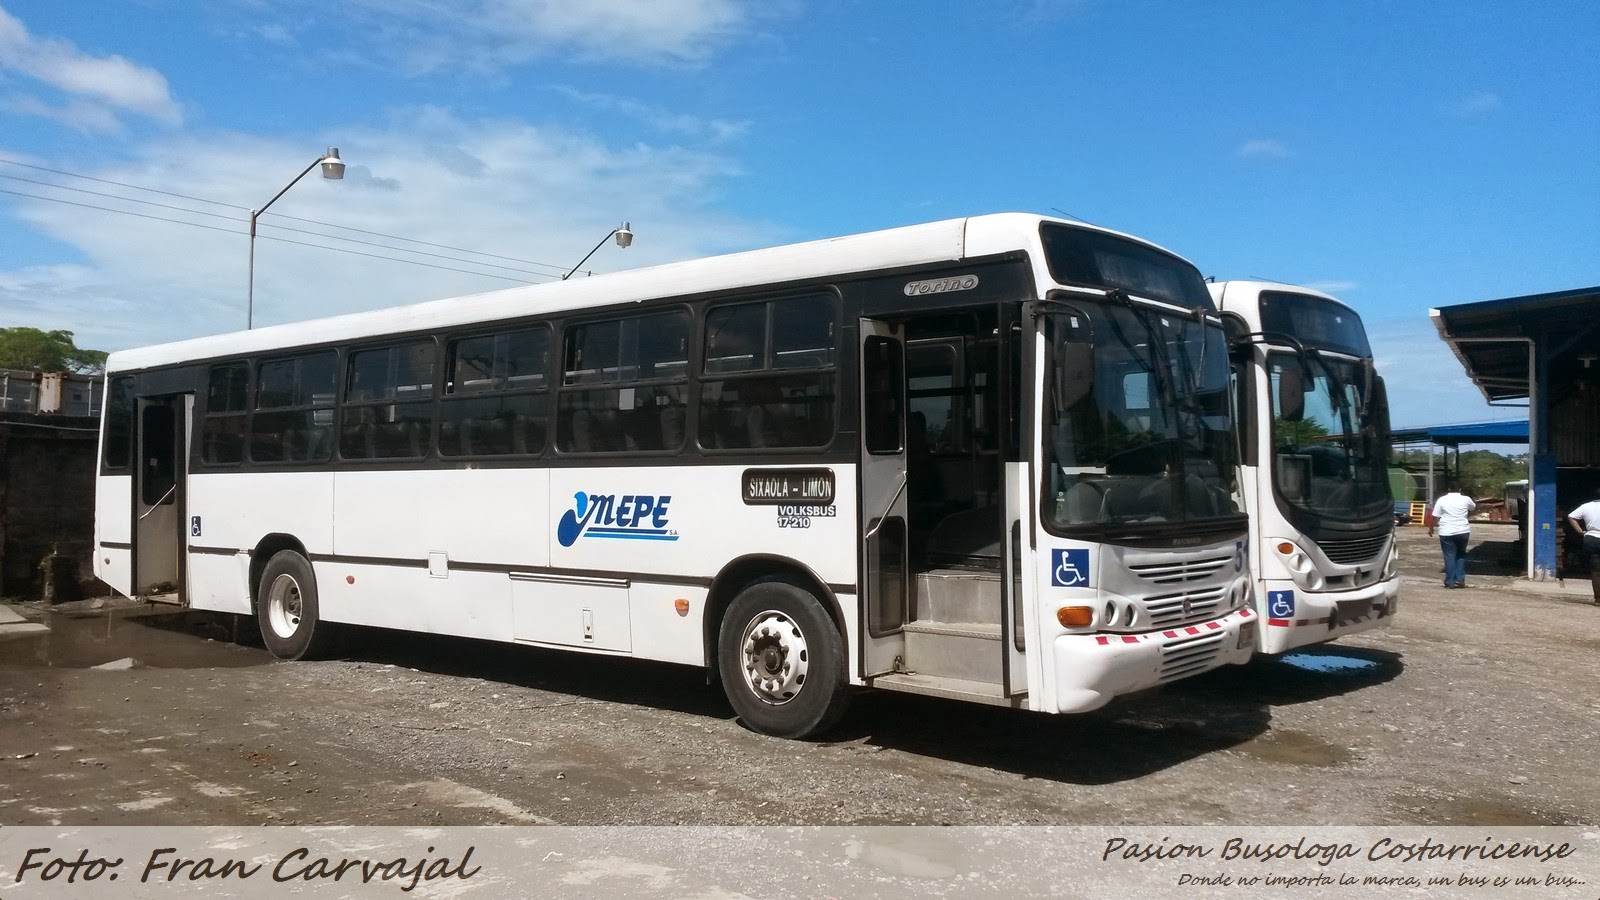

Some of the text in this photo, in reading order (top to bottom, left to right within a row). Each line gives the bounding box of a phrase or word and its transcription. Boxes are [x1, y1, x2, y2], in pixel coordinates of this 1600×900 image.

[908, 279, 975, 295] Torino
[749, 477, 789, 497] SIXAOLA
[588, 494, 672, 529] MEPE
[779, 505, 835, 516] VOLKSBUS
